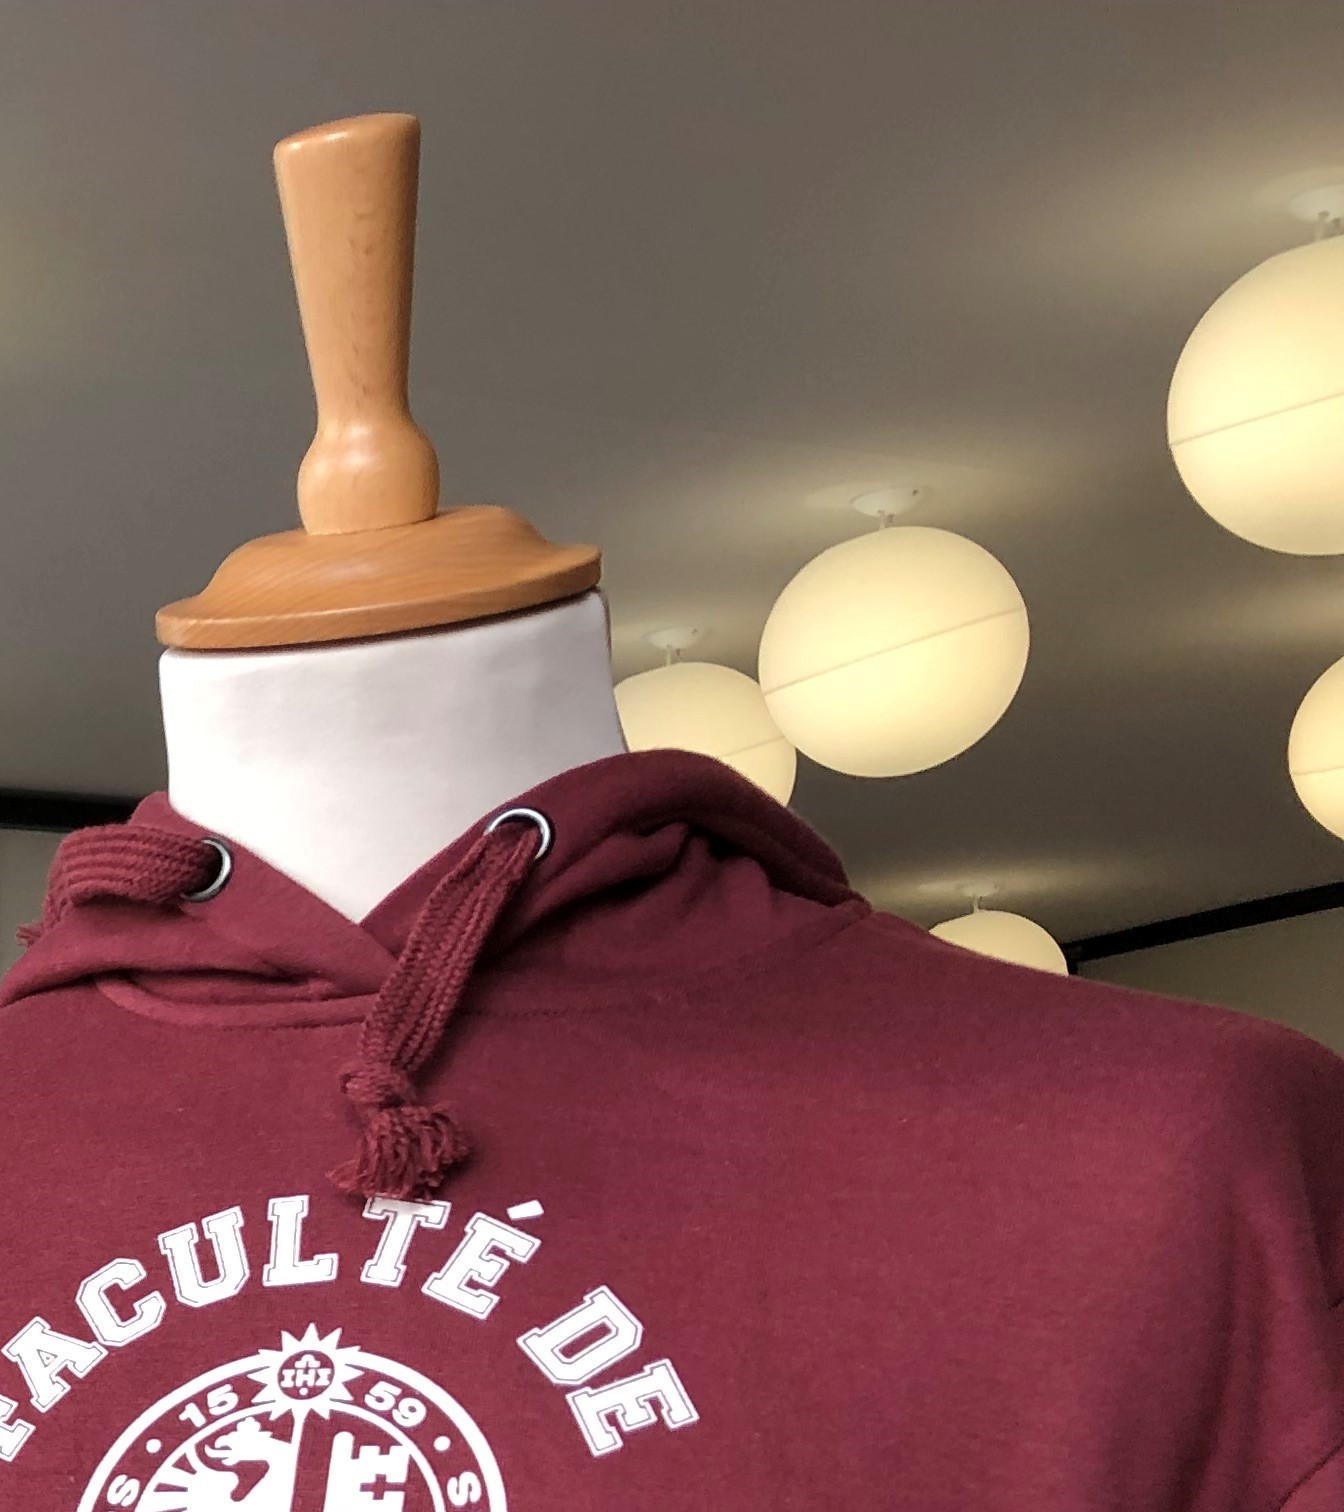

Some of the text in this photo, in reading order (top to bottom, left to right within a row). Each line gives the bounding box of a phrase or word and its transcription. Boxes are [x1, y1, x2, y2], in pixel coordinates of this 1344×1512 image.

[178, 1380, 428, 1429] 15 59
[516, 1284, 700, 1458] DE
